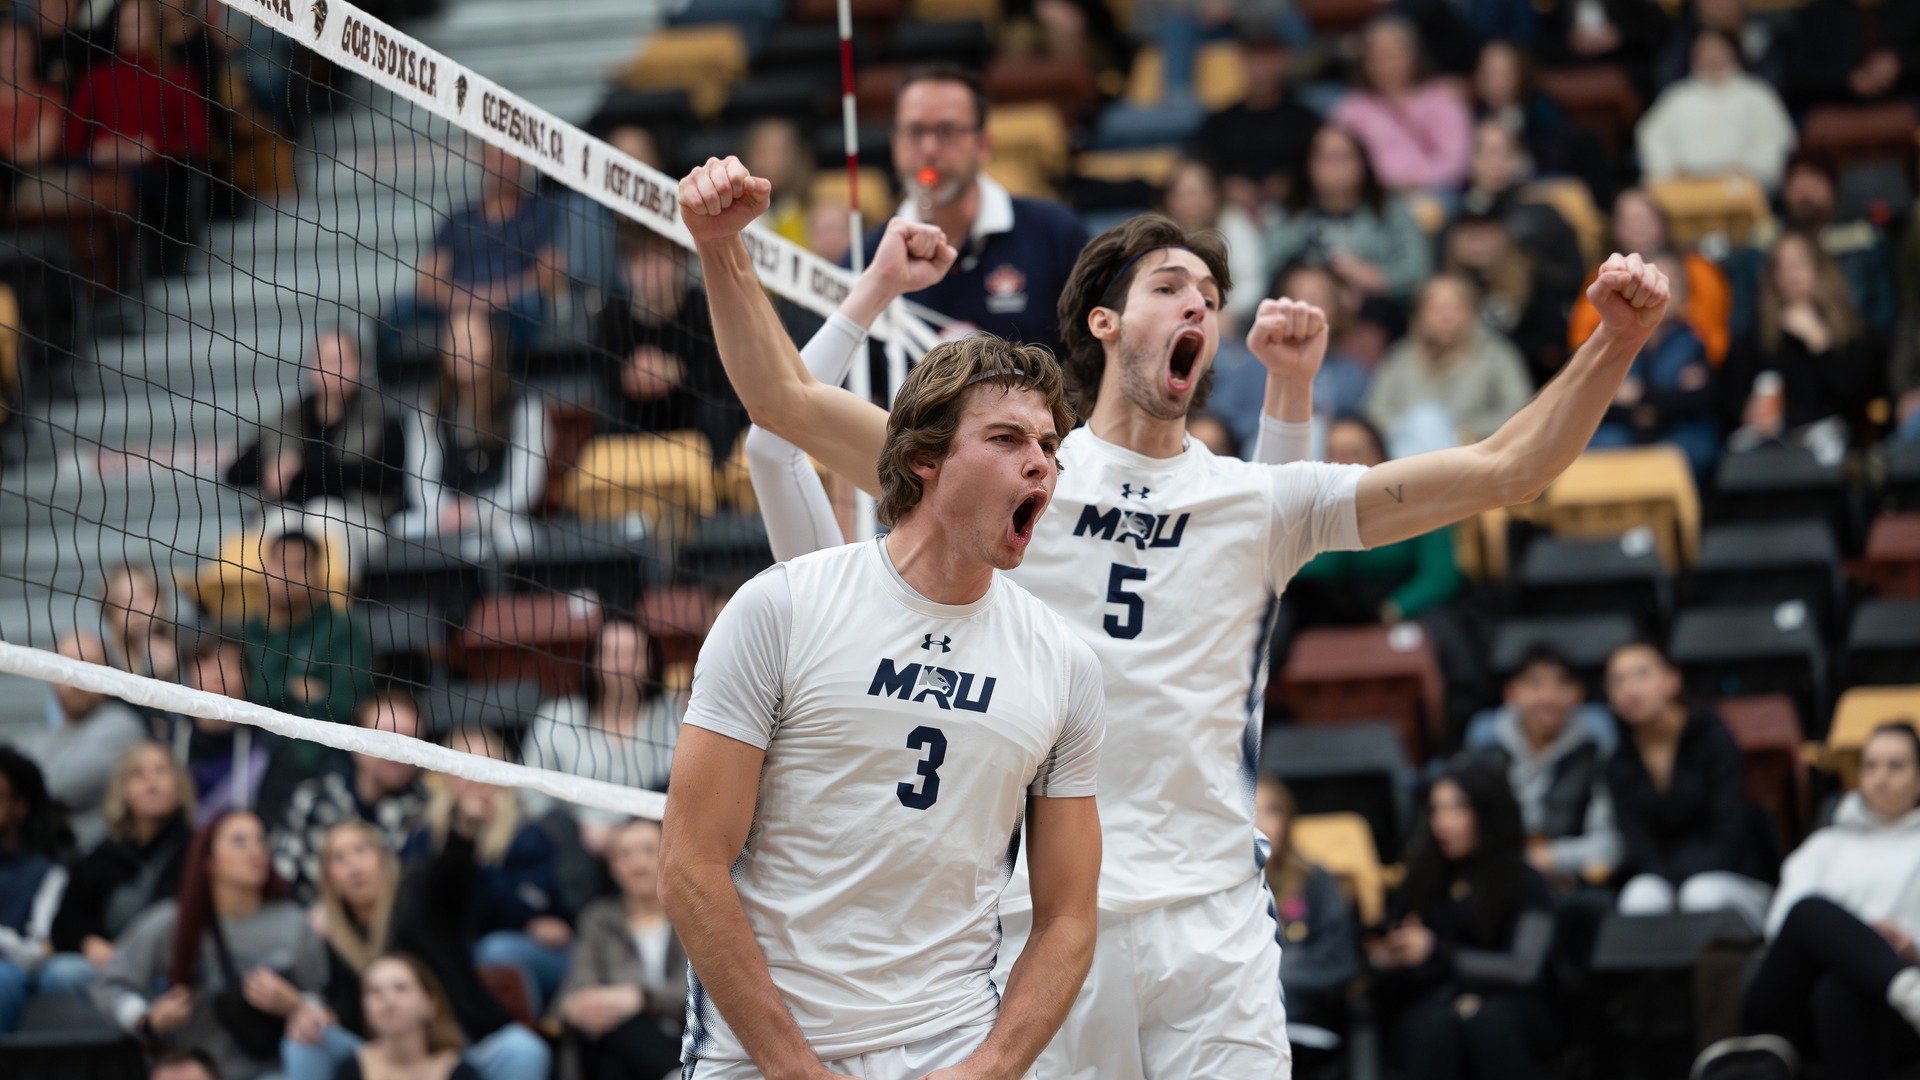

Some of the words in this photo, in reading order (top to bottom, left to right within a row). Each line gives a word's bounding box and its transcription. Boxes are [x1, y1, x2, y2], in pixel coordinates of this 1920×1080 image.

[1072, 504, 1191, 550] MRU
[1103, 562, 1147, 640] 5
[867, 658, 997, 713] MRU
[896, 725, 948, 811] 3
